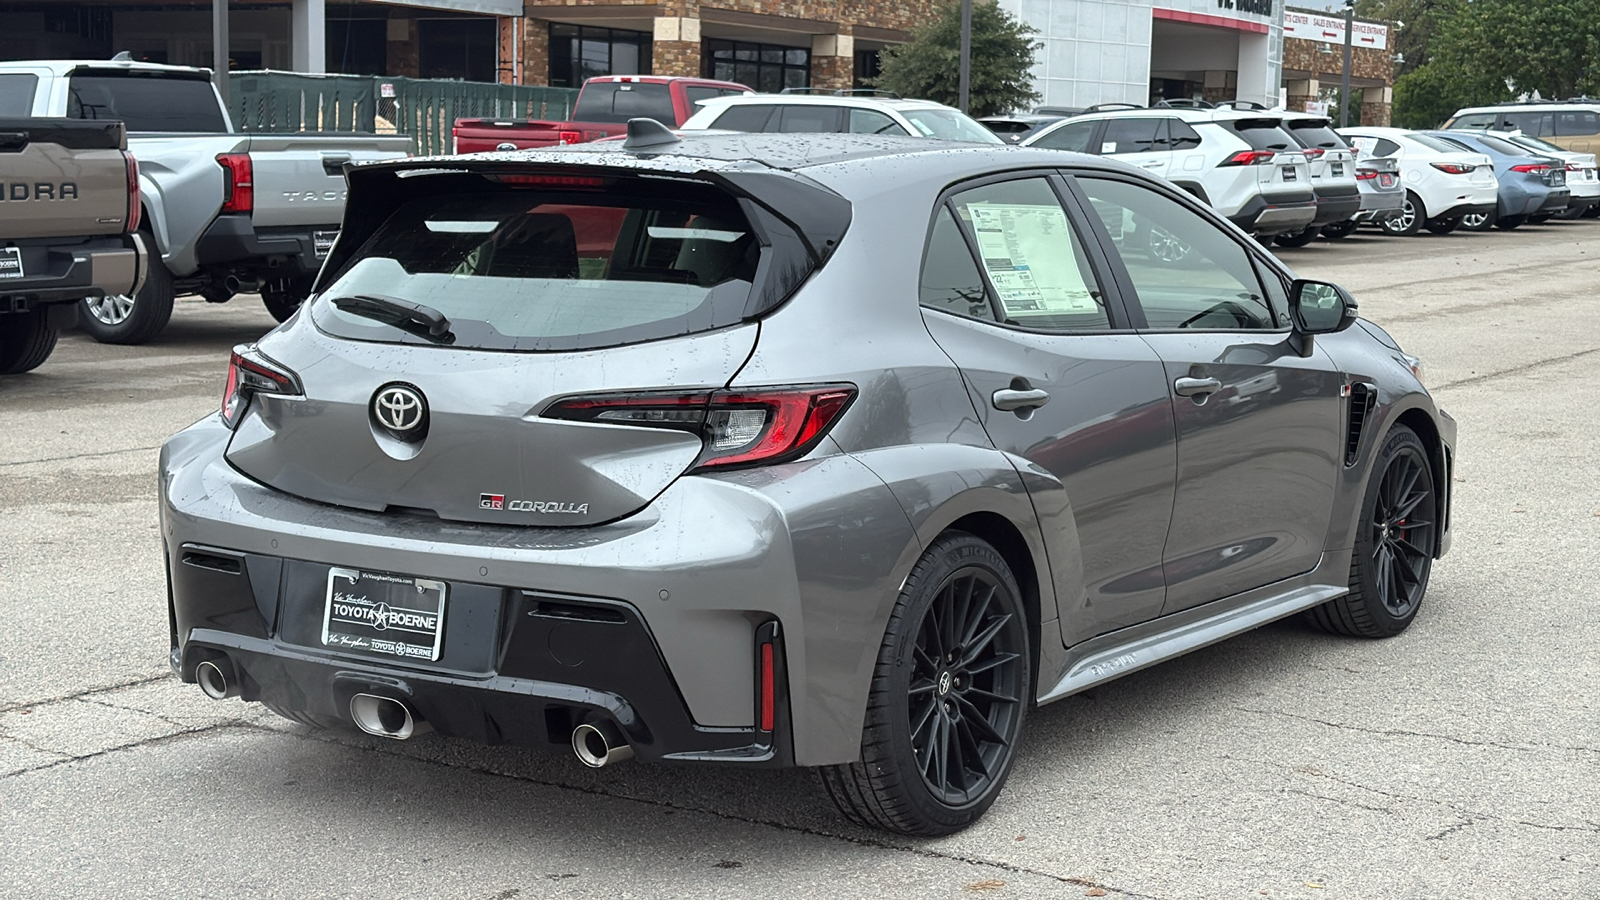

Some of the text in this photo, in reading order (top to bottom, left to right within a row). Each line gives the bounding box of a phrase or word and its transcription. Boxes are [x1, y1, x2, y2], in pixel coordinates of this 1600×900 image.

[1293, 15, 1309, 26] CENTER
[1313, 17, 1346, 31] SALES ENTRANC
[1366, 25, 1386, 36] ENTRANCE
[0, 182, 79, 201] DRA
[507, 500, 589, 515] COROLLA
[362, 573, 413, 585] VicVaughanToyota.com
[333, 604, 437, 630] TOYOTA BOERNE
[371, 641, 395, 652] TOYOTA
[405, 647, 433, 657] BOERNE
